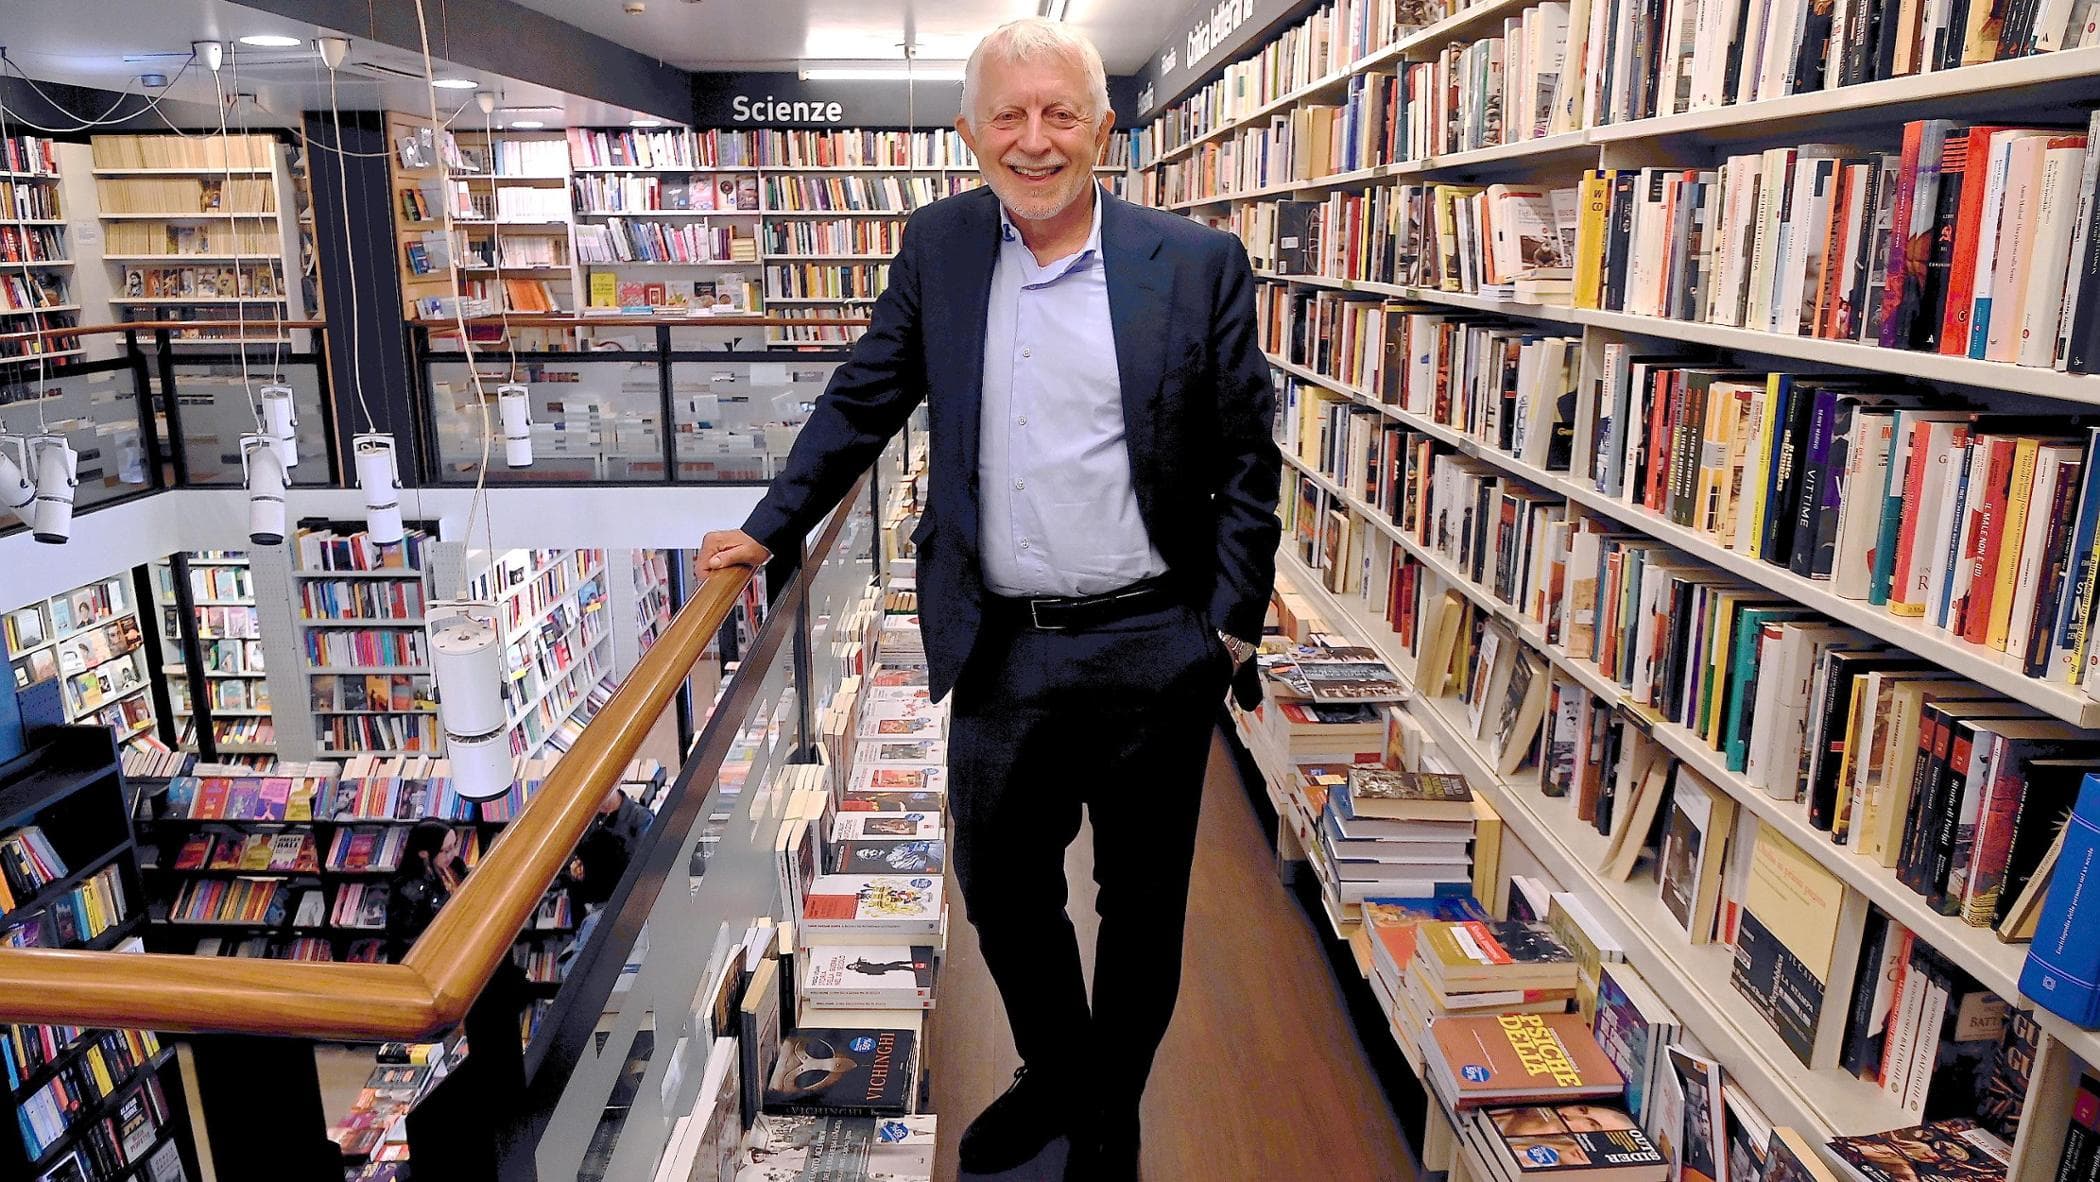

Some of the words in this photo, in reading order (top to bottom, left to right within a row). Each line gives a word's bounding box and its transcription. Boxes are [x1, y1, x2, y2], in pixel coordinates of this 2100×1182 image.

[732, 95, 843, 122] Scienze
[1784, 450, 1794, 479] mito
[1800, 469, 1816, 528] VITTIME
[1984, 502, 1992, 510] IL
[1979, 512, 1991, 535] MALE
[1977, 535, 1987, 554] NON
[1972, 563, 1982, 577] QUI
[1945, 807, 1954, 817] di
[1940, 818, 1952, 845] Parigi
[1496, 1014, 1550, 1078] DELIA
[1518, 1014, 1583, 1088] PSICHE
[866, 1032, 896, 1101] VICHINGHI
